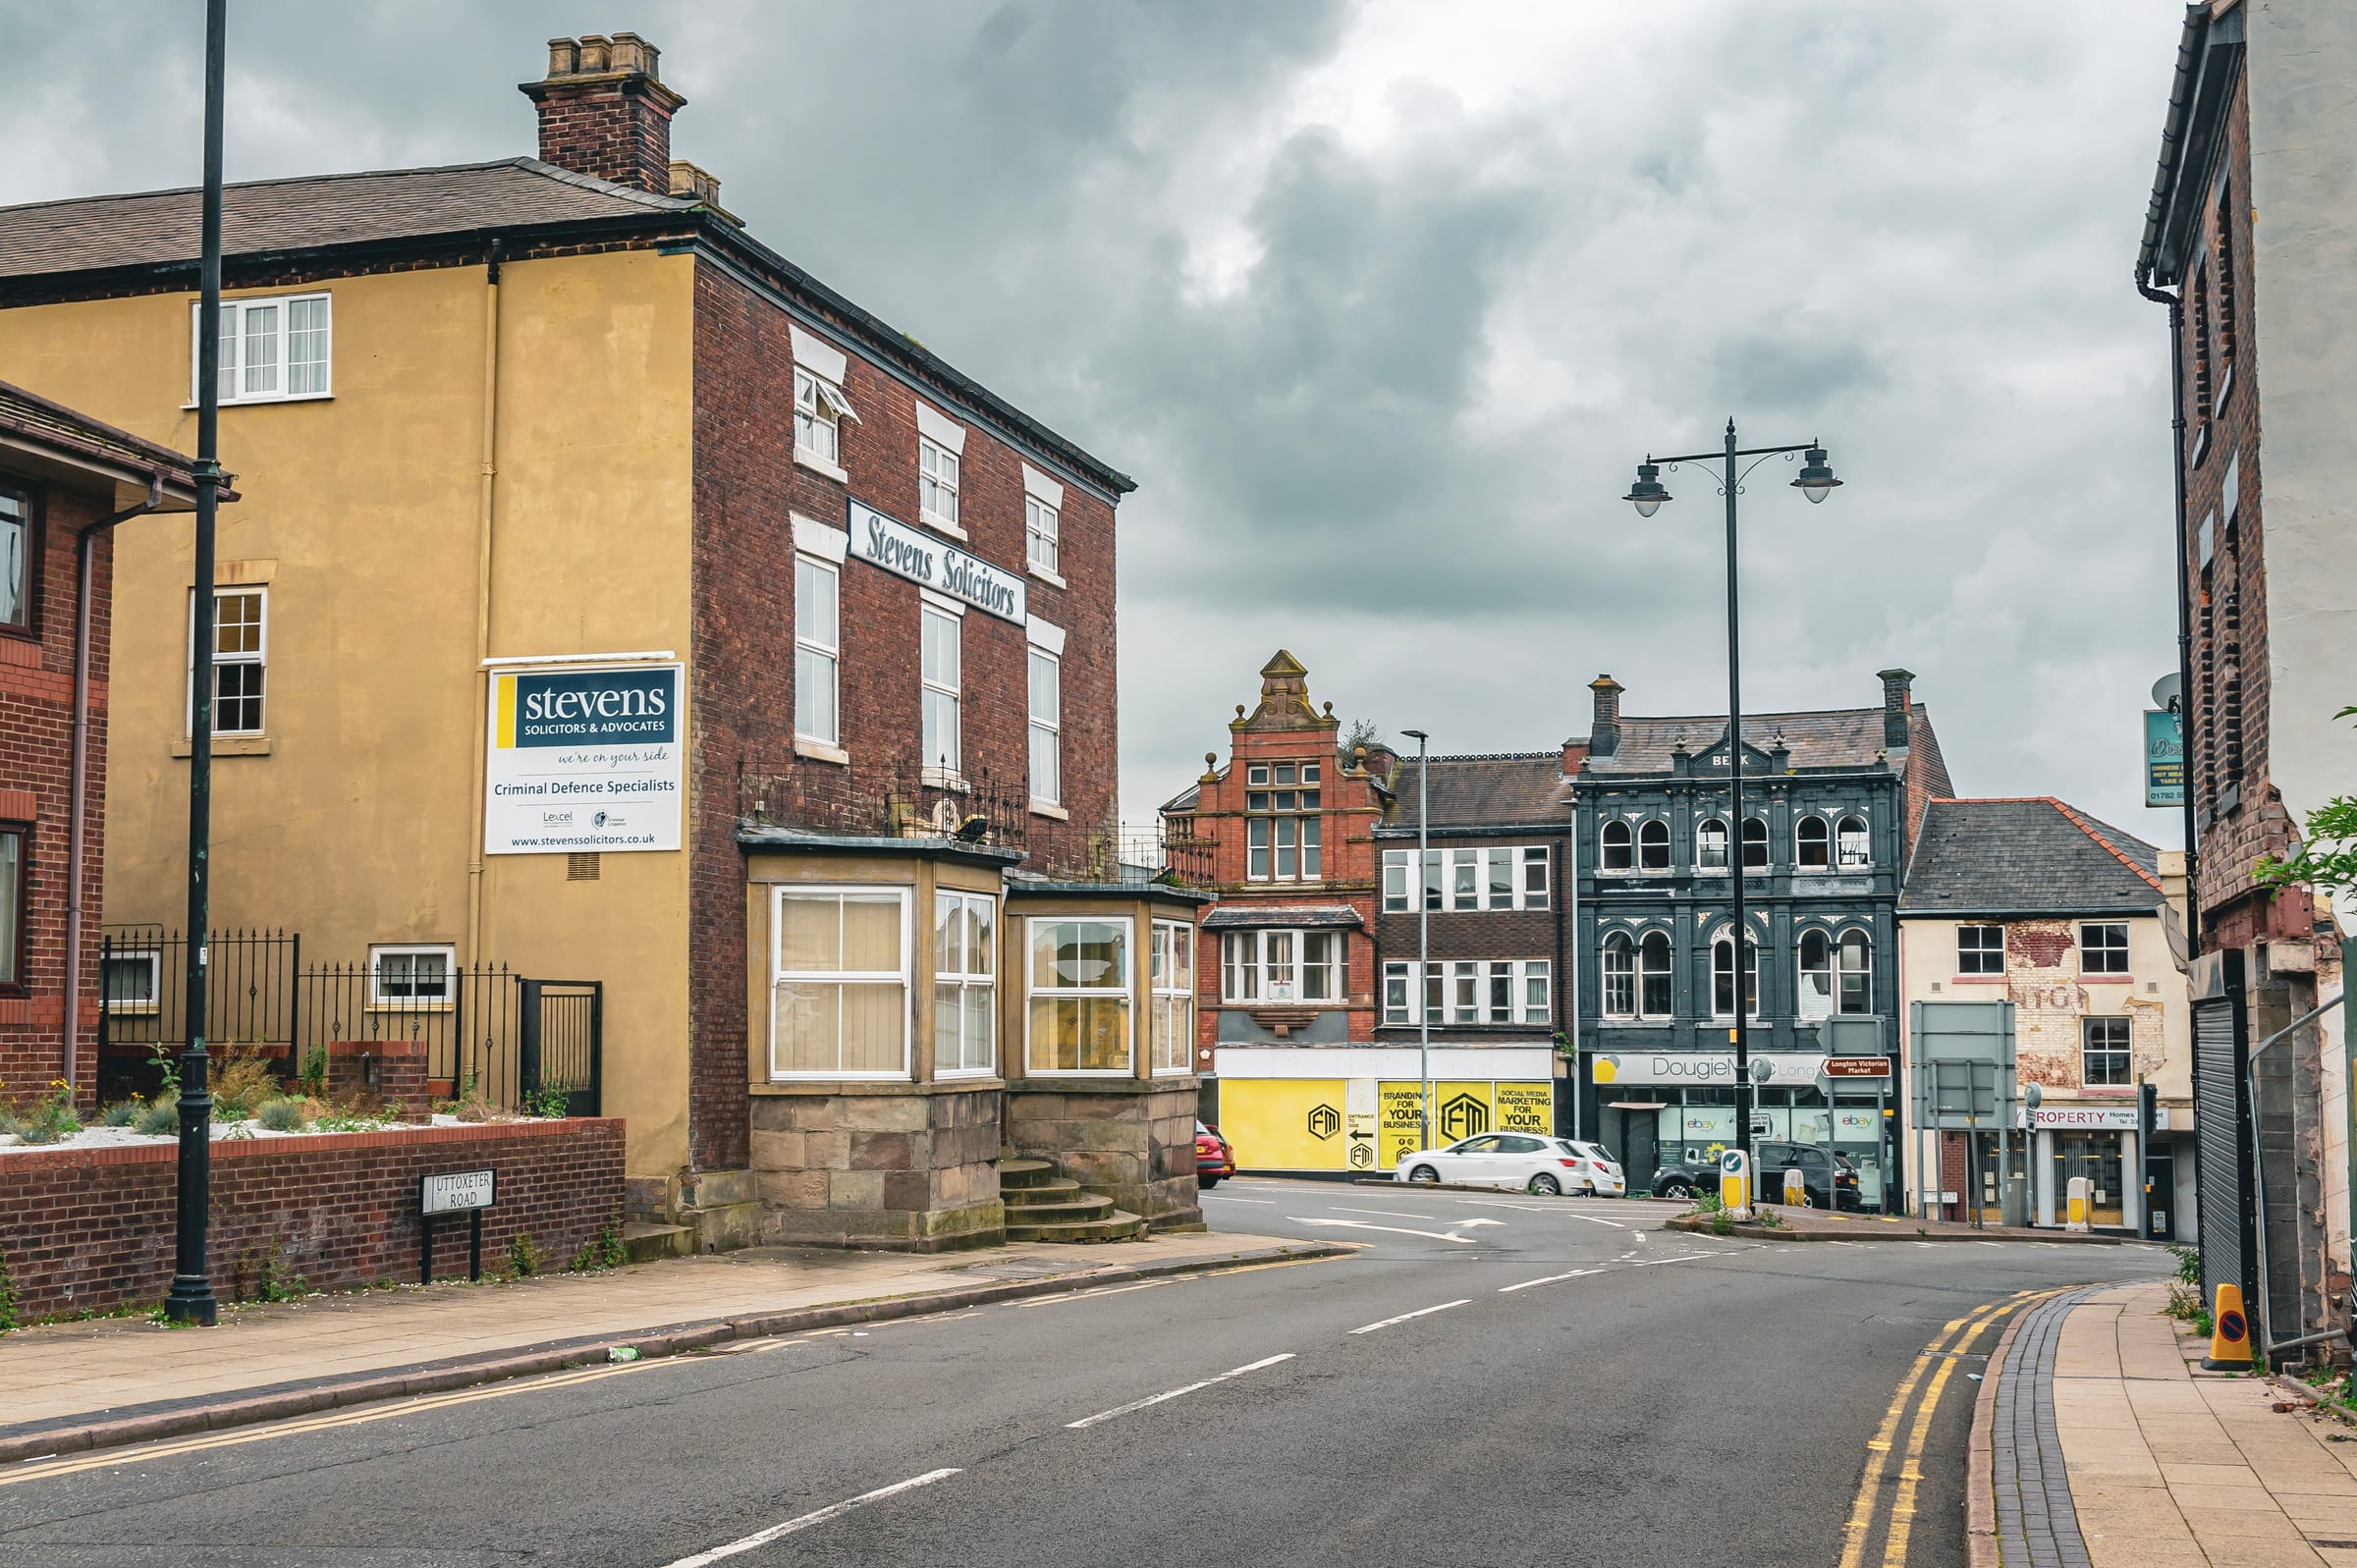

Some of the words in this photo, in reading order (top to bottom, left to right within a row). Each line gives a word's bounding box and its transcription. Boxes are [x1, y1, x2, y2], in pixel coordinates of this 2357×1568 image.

[867, 515, 932, 581] Stevens
[942, 549, 1014, 616] Solicitors
[525, 687, 666, 720] stevens
[525, 724, 586, 735] SOLICITORS
[589, 723, 598, 733] &
[601, 721, 665, 732] ADVOCATES
[558, 751, 589, 764] we're
[593, 754, 608, 763] on
[611, 753, 639, 769] your
[643, 746, 670, 761] side
[1713, 755, 1749, 766] BEK
[494, 783, 547, 796] Criminal
[551, 782, 604, 794] Defence
[607, 780, 675, 794] Specialists
[543, 811, 573, 822] Lexcel
[512, 834, 655, 846] www.stevenssolicitors.co.uk
[1498, 1097, 1551, 1106] MARKETING
[1389, 1109, 1423, 1119] YOUR
[1505, 1114, 1541, 1125] YOUR
[2037, 1111, 2106, 1123] ROPERTY
[1687, 1118, 1717, 1130] ebay
[1842, 1115, 1873, 1127] ebay
[1500, 1125, 1549, 1134] BUSINESS?
[437, 1173, 490, 1191] UTTOXETER
[450, 1191, 477, 1208] ROAD
